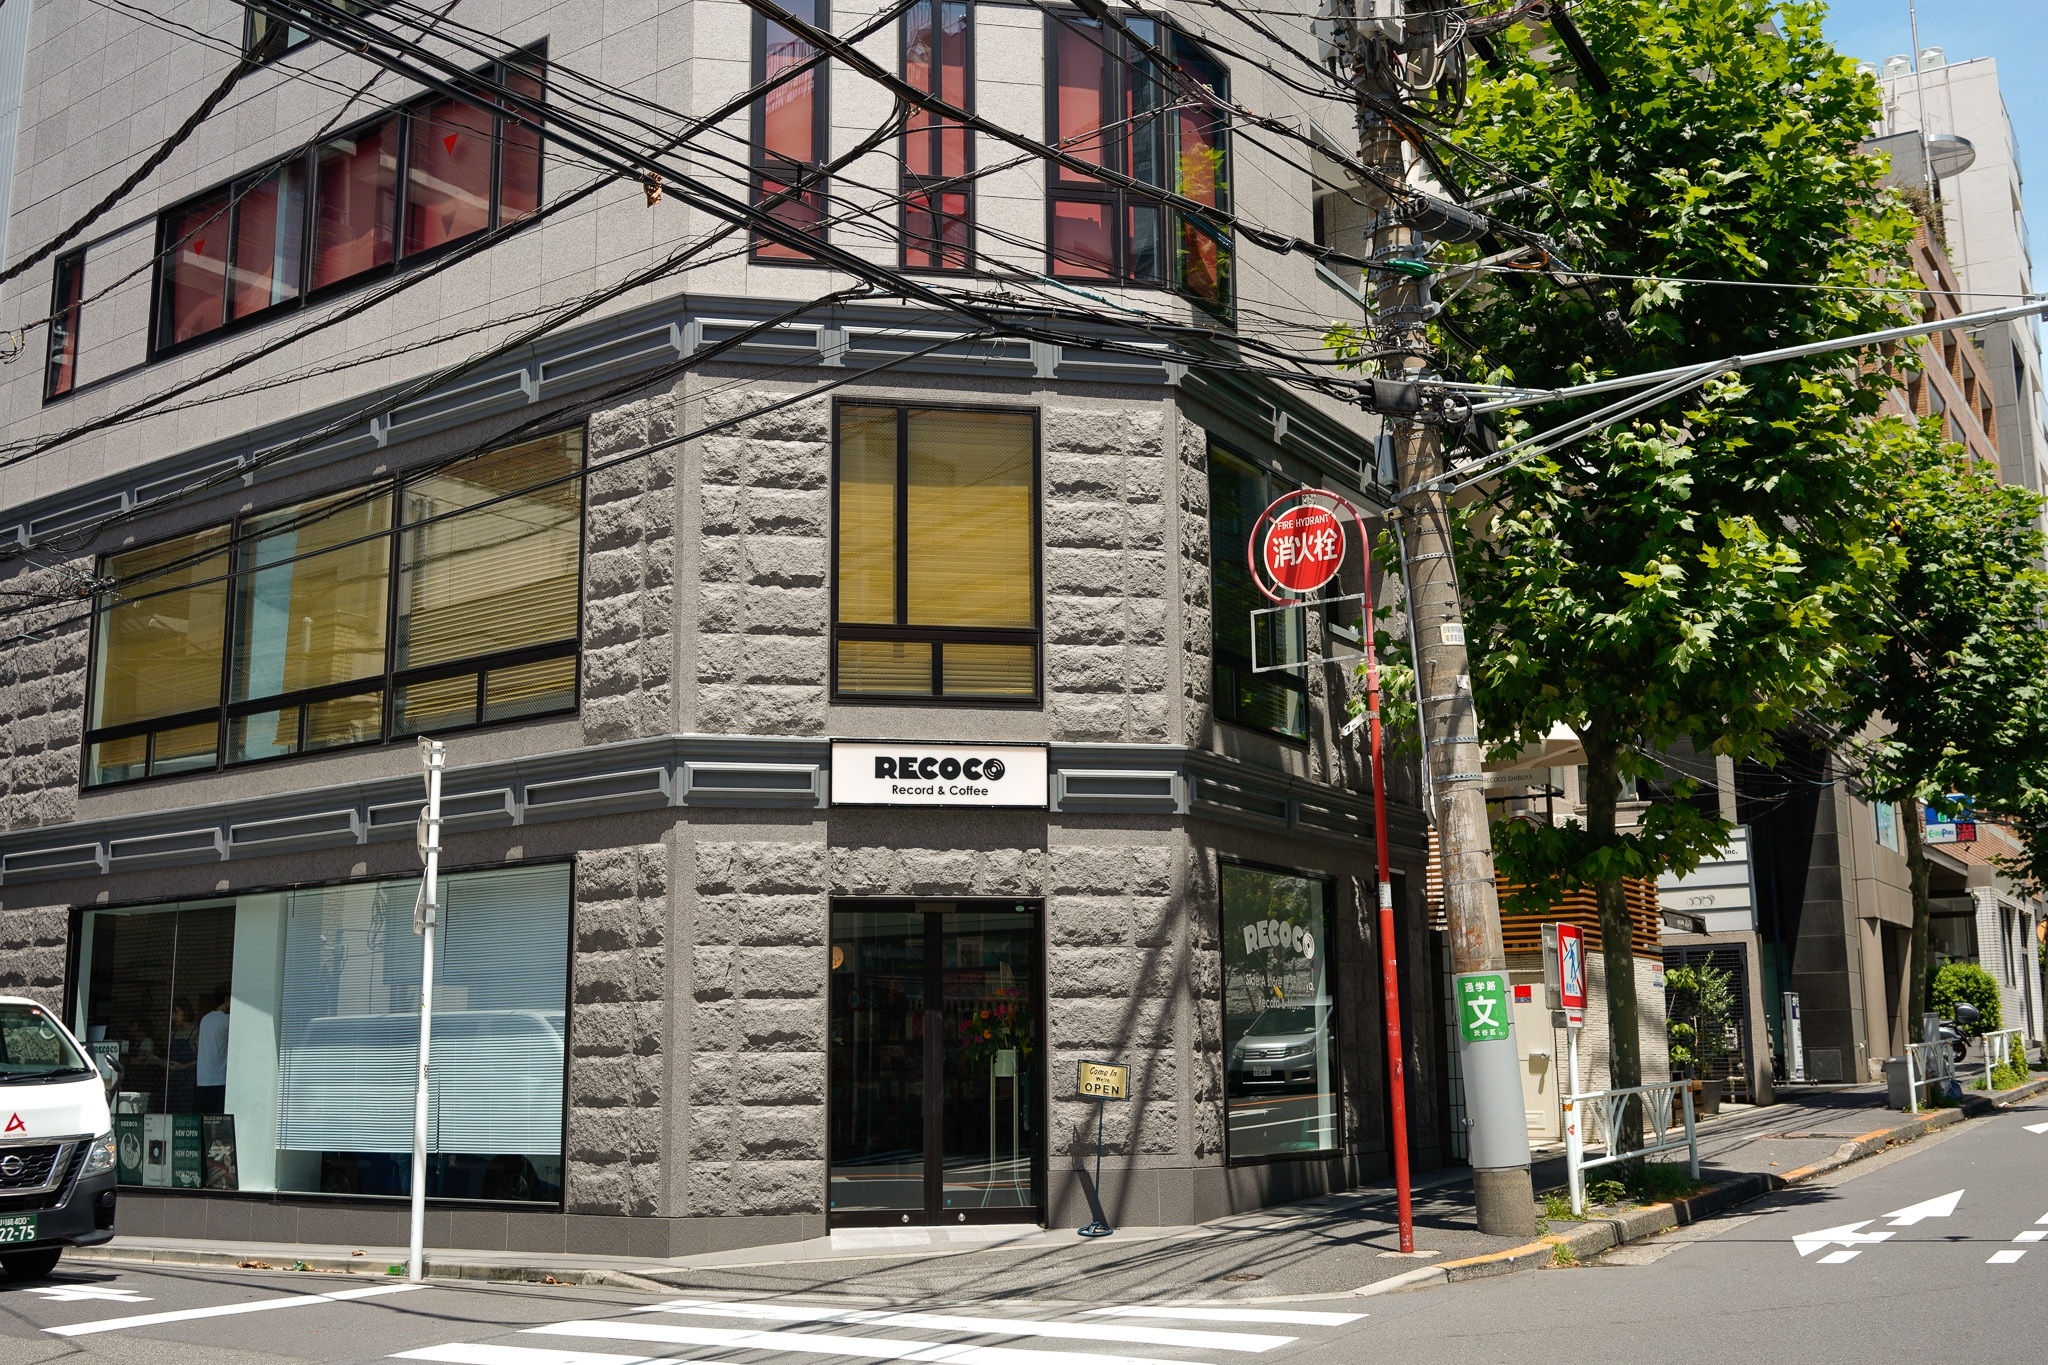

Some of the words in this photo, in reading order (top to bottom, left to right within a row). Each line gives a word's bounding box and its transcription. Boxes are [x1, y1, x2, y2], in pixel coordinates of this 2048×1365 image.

[1277, 519, 1294, 531] FIRE
[1295, 513, 1330, 528] HYDRANT
[1272, 527, 1338, 569] 消火栓
[874, 756, 1006, 781] RECOCO
[1483, 776, 1507, 784] RECOCO
[1507, 774, 1533, 782] SHIBUYA
[892, 784, 934, 795] Record
[937, 785, 945, 795] &
[949, 785, 989, 796] Coffee
[1243, 919, 1315, 960] RECOCO
[1245, 973, 1260, 986] Side
[1267, 976, 1282, 988] store
[1464, 981, 1496, 993] 通学路
[1258, 996, 1280, 1009] Record
[1467, 995, 1500, 1029] 文
[1473, 1028, 1497, 1037] 渋谷区
[1090, 1066, 1109, 1077] Come
[1110, 1069, 1118, 1078] In
[1085, 1082, 1120, 1095] OPEN
[14, 1216, 27, 1224] 400
[0, 1225, 35, 1241] 22-75
